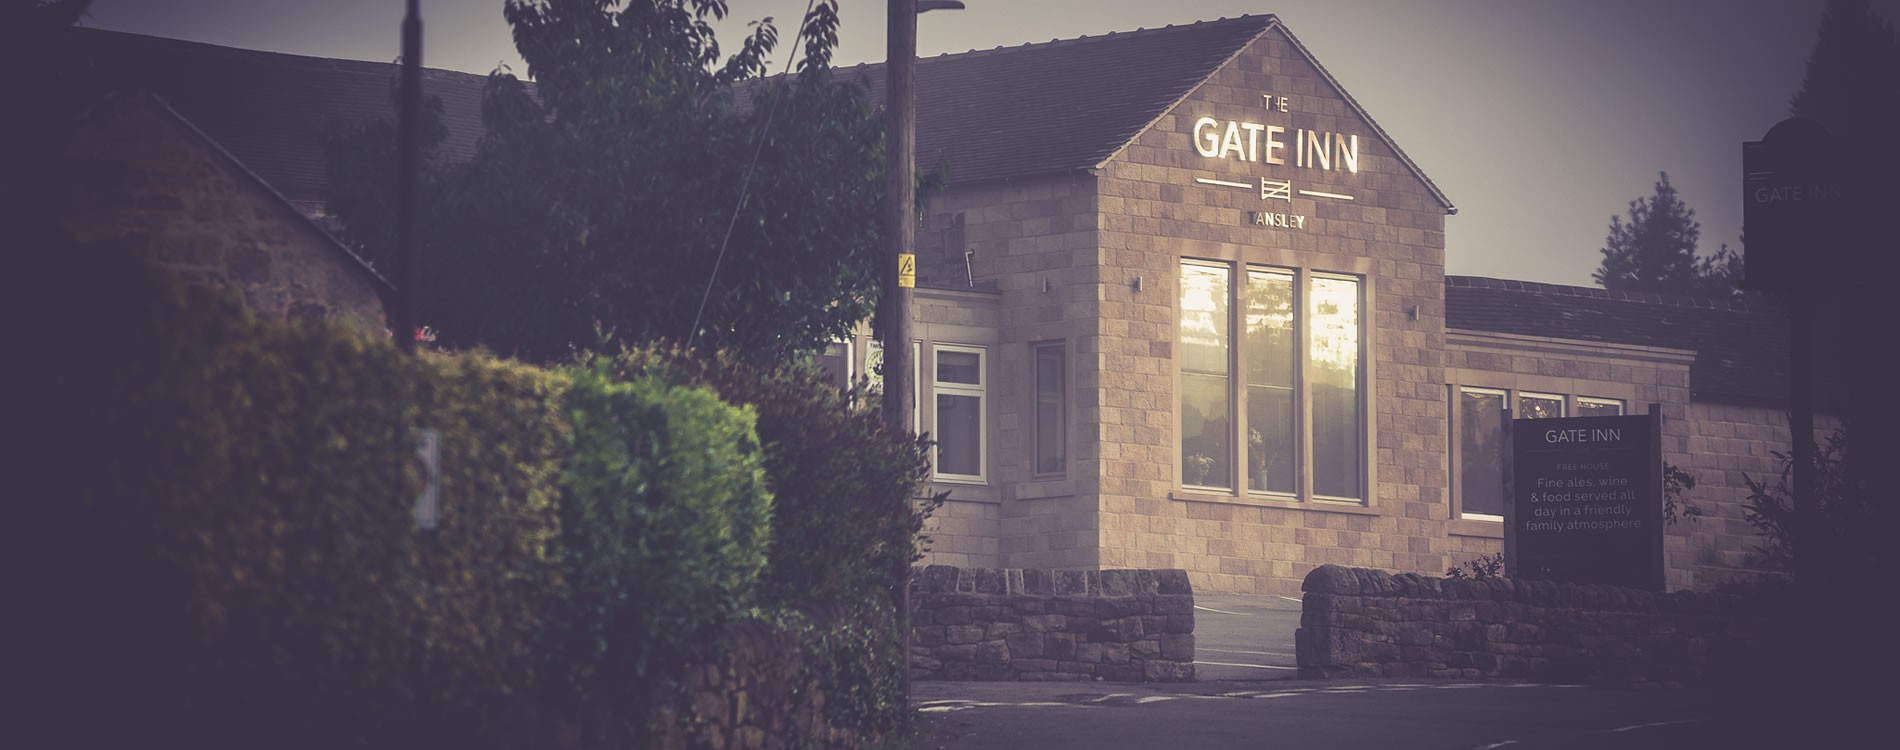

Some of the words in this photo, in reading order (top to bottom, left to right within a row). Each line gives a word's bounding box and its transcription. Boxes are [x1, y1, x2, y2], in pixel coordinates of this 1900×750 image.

[1264, 94, 1288, 112] THE
[1193, 117, 1285, 165] GATE
[1297, 128, 1358, 173] INN
[1755, 186, 1802, 203] GATE
[1545, 429, 1587, 443] GATE
[1592, 428, 1621, 442] INN
[1557, 463, 1578, 471] FREE
[1538, 478, 1564, 488] Fine
[1599, 476, 1628, 486] wine
[1531, 492, 1539, 503] &
[1543, 492, 1571, 502] food
[1575, 491, 1617, 501] served
[1620, 490, 1635, 500] all
[1535, 506, 1556, 518] day
[1560, 506, 1570, 516] in
[1584, 504, 1632, 517] friendly
[1526, 521, 1564, 533] family
[1567, 519, 1641, 531] atmosphere
